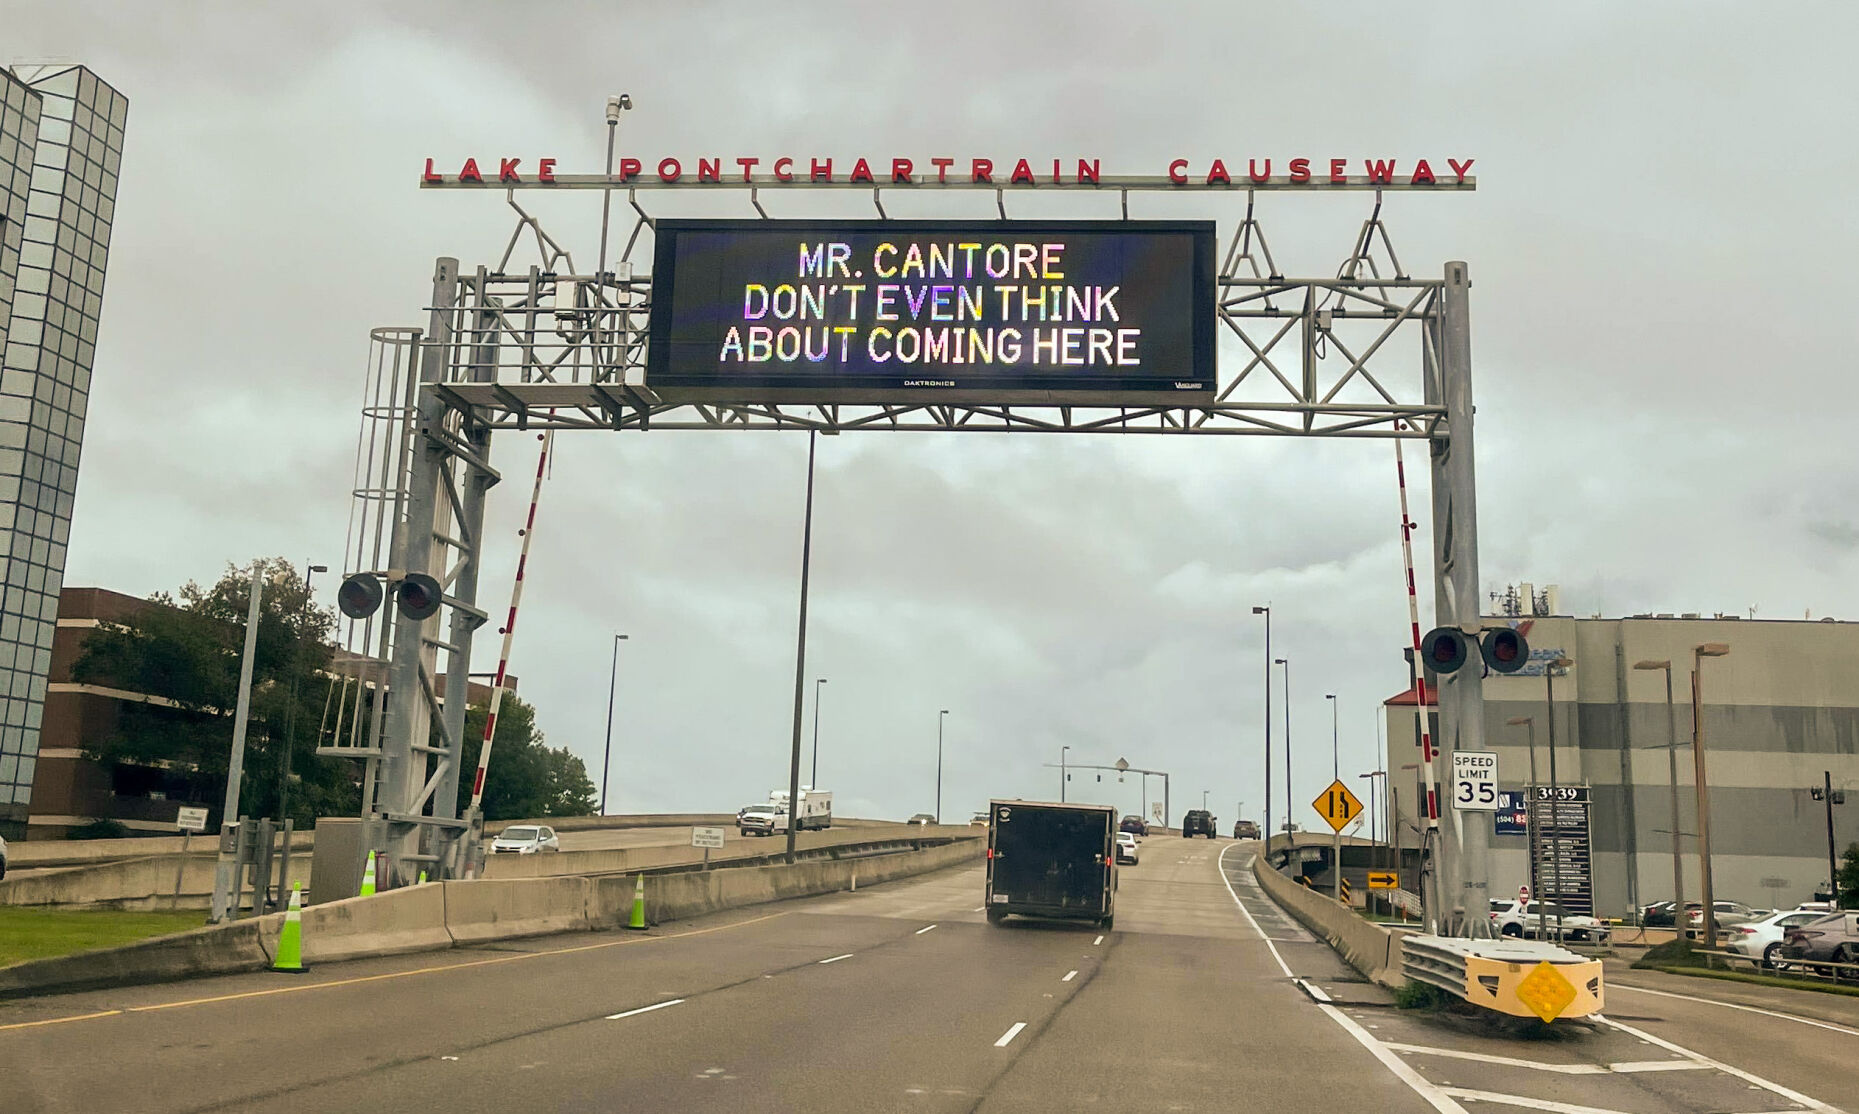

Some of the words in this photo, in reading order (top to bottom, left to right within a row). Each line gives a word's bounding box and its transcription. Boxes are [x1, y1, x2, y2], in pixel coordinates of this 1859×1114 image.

[424, 158, 556, 182] LAKE
[619, 157, 1101, 183] PONTCHARTRAIN
[1169, 158, 1475, 184] CAUSEWAY
[798, 242, 863, 278] MR.
[873, 242, 1066, 280] CANTORE
[744, 284, 867, 321] DON'T
[877, 284, 983, 322] EVEN
[994, 284, 1121, 323] THINK
[719, 326, 858, 363] ABOUT
[867, 326, 1022, 365] COMING
[1032, 327, 1142, 366] HERE
[1455, 757, 1494, 767] SPEED
[1458, 769, 1489, 779] LIMIT
[1458, 781, 1495, 803] 35
